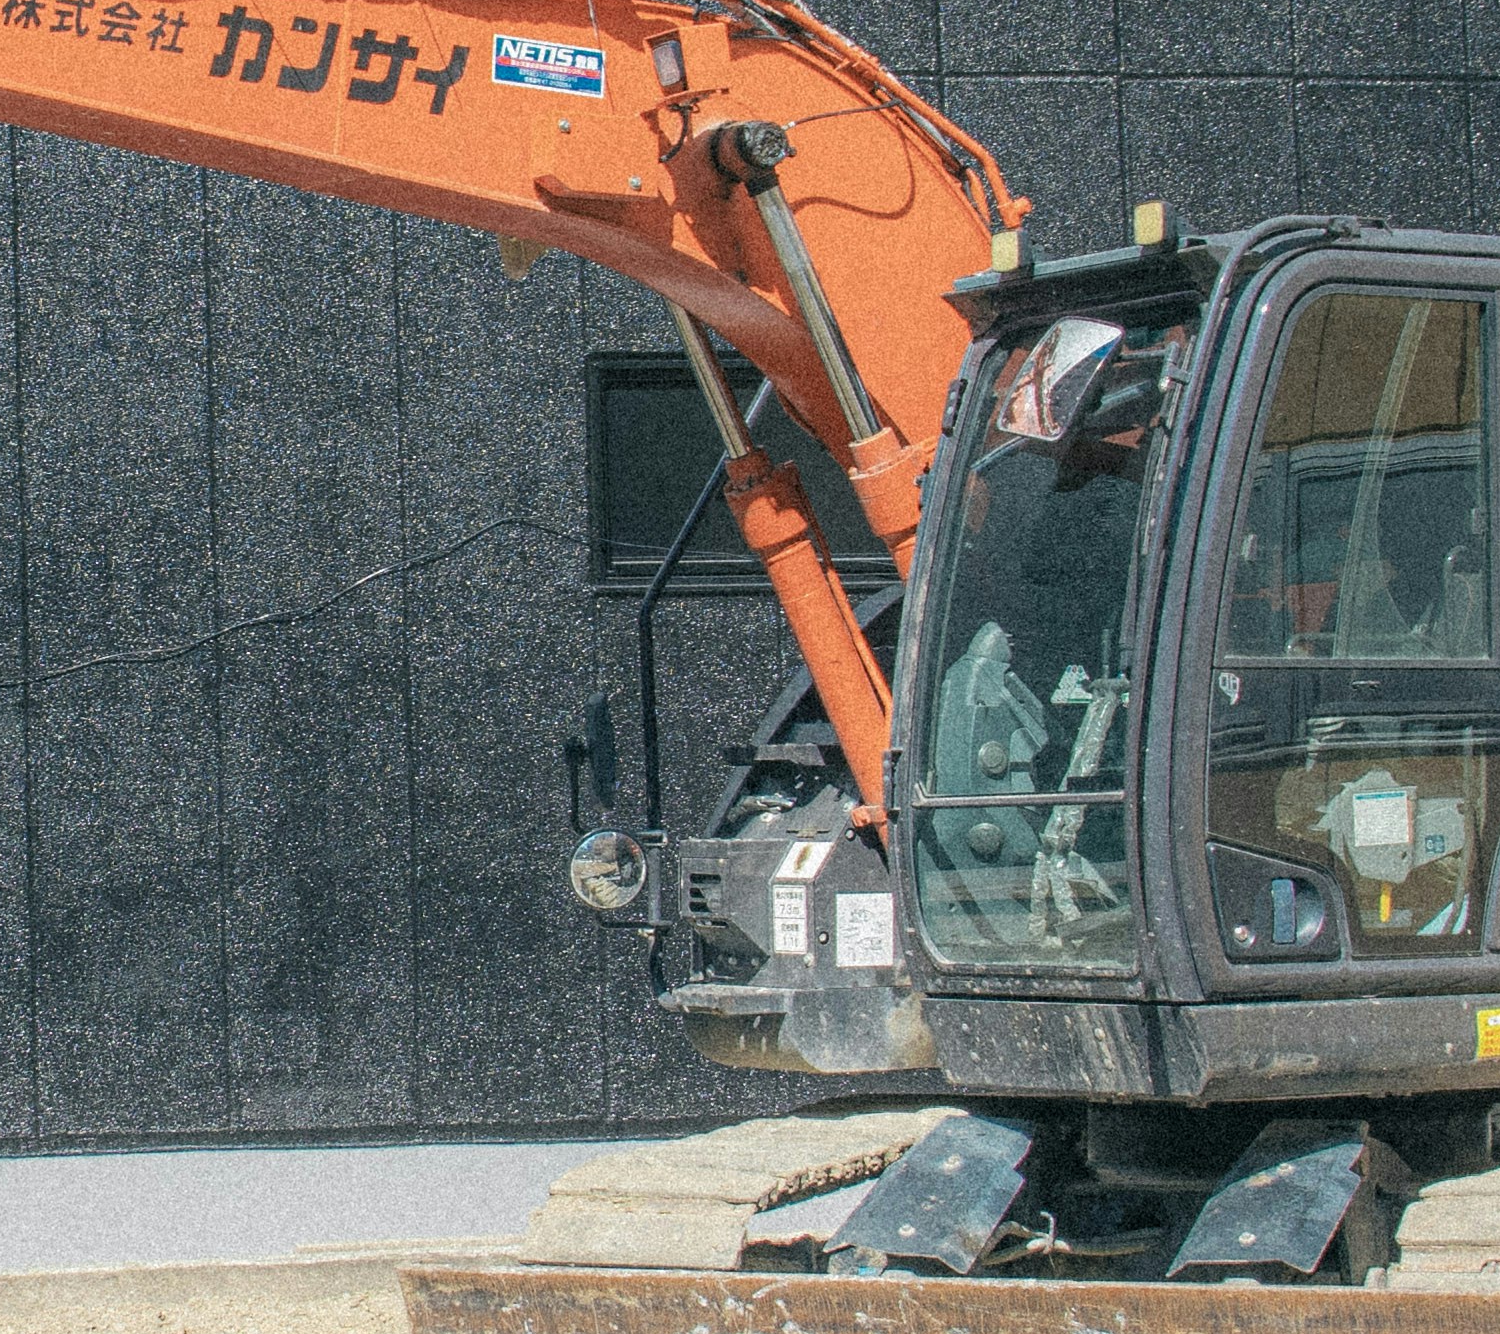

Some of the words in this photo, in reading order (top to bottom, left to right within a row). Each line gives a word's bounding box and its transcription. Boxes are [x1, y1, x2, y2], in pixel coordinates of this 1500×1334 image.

[209, 5, 470, 115] カンサイ
[499, 39, 574, 66] NETIS
